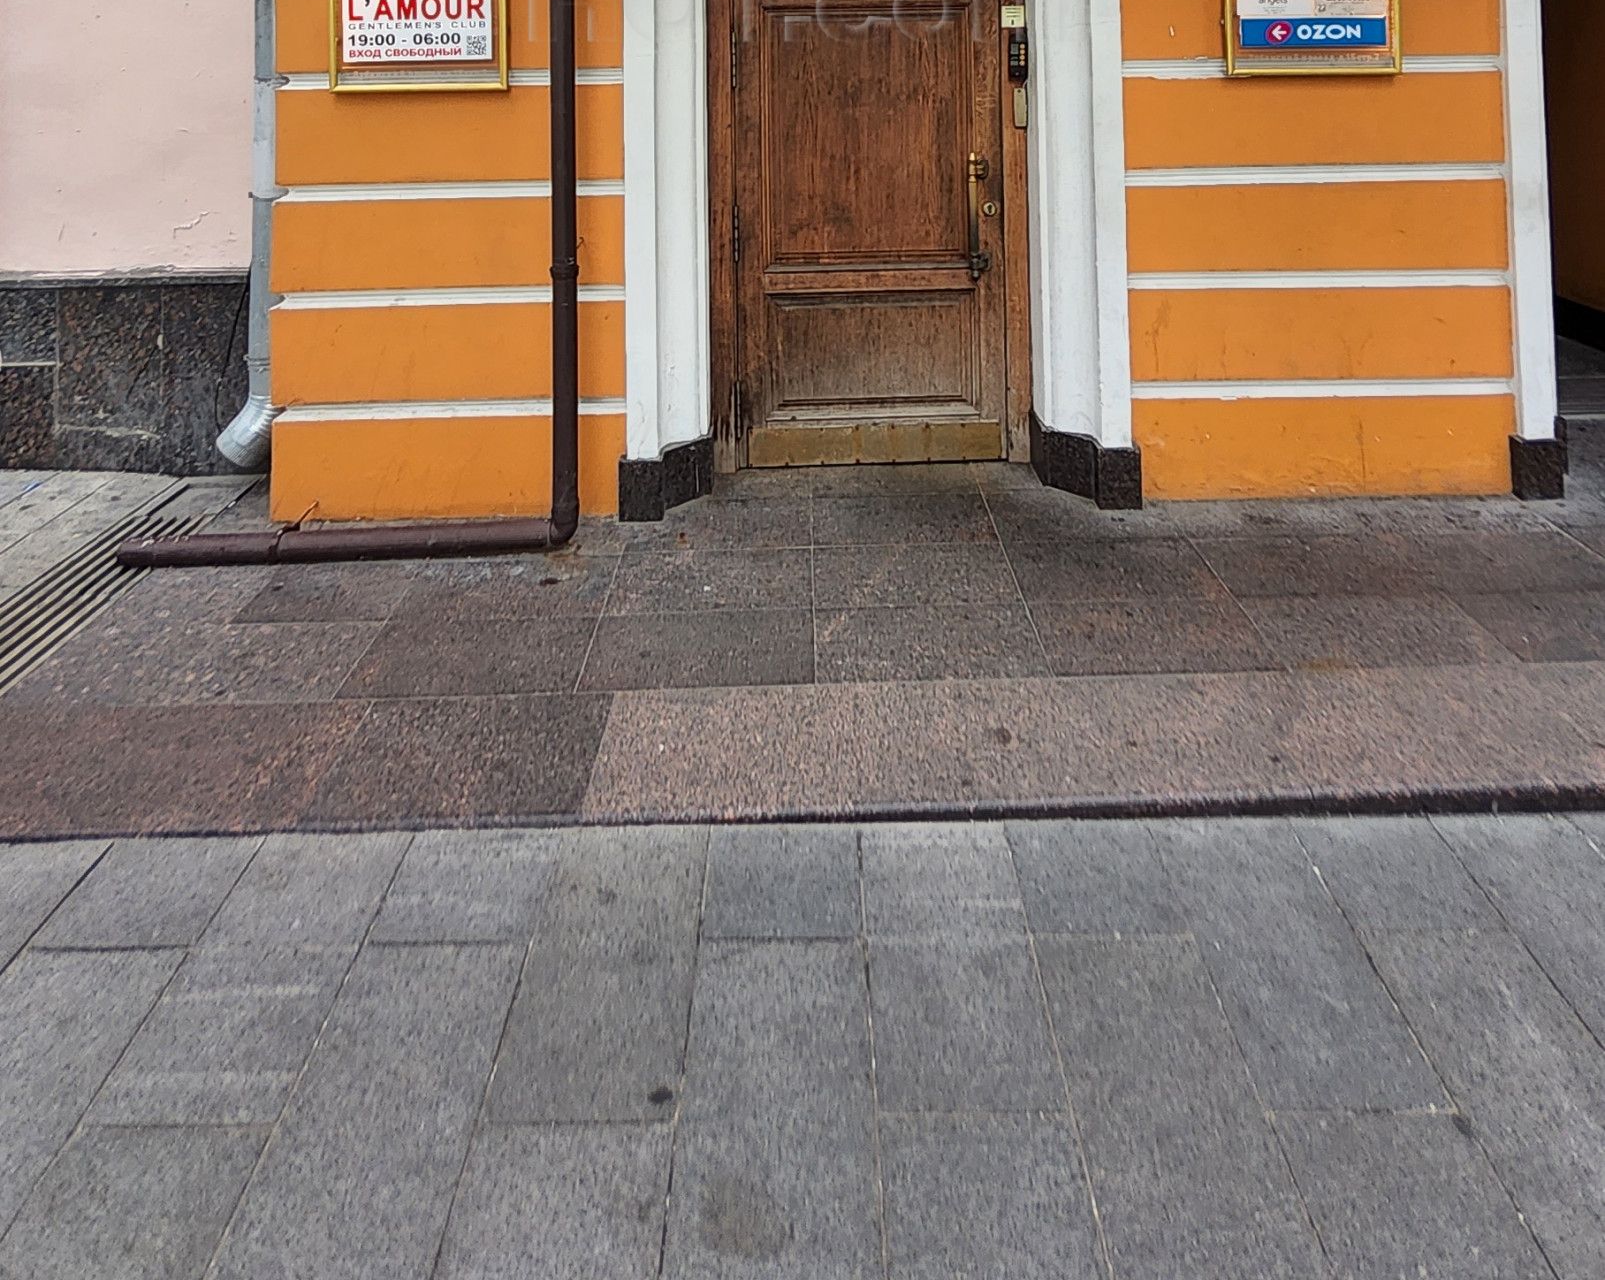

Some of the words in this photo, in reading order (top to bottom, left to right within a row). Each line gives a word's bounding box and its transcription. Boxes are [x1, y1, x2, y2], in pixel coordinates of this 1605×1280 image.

[348, 22, 442, 31] GENTLEMEN'S
[450, 20, 486, 29] CLUB
[1296, 23, 1361, 40] OZON
[348, 34, 396, 47] 19:00
[412, 33, 461, 45] 06:00
[349, 48, 382, 59] ВХОД
[385, 46, 462, 58] СВОБОДНЫЙ
